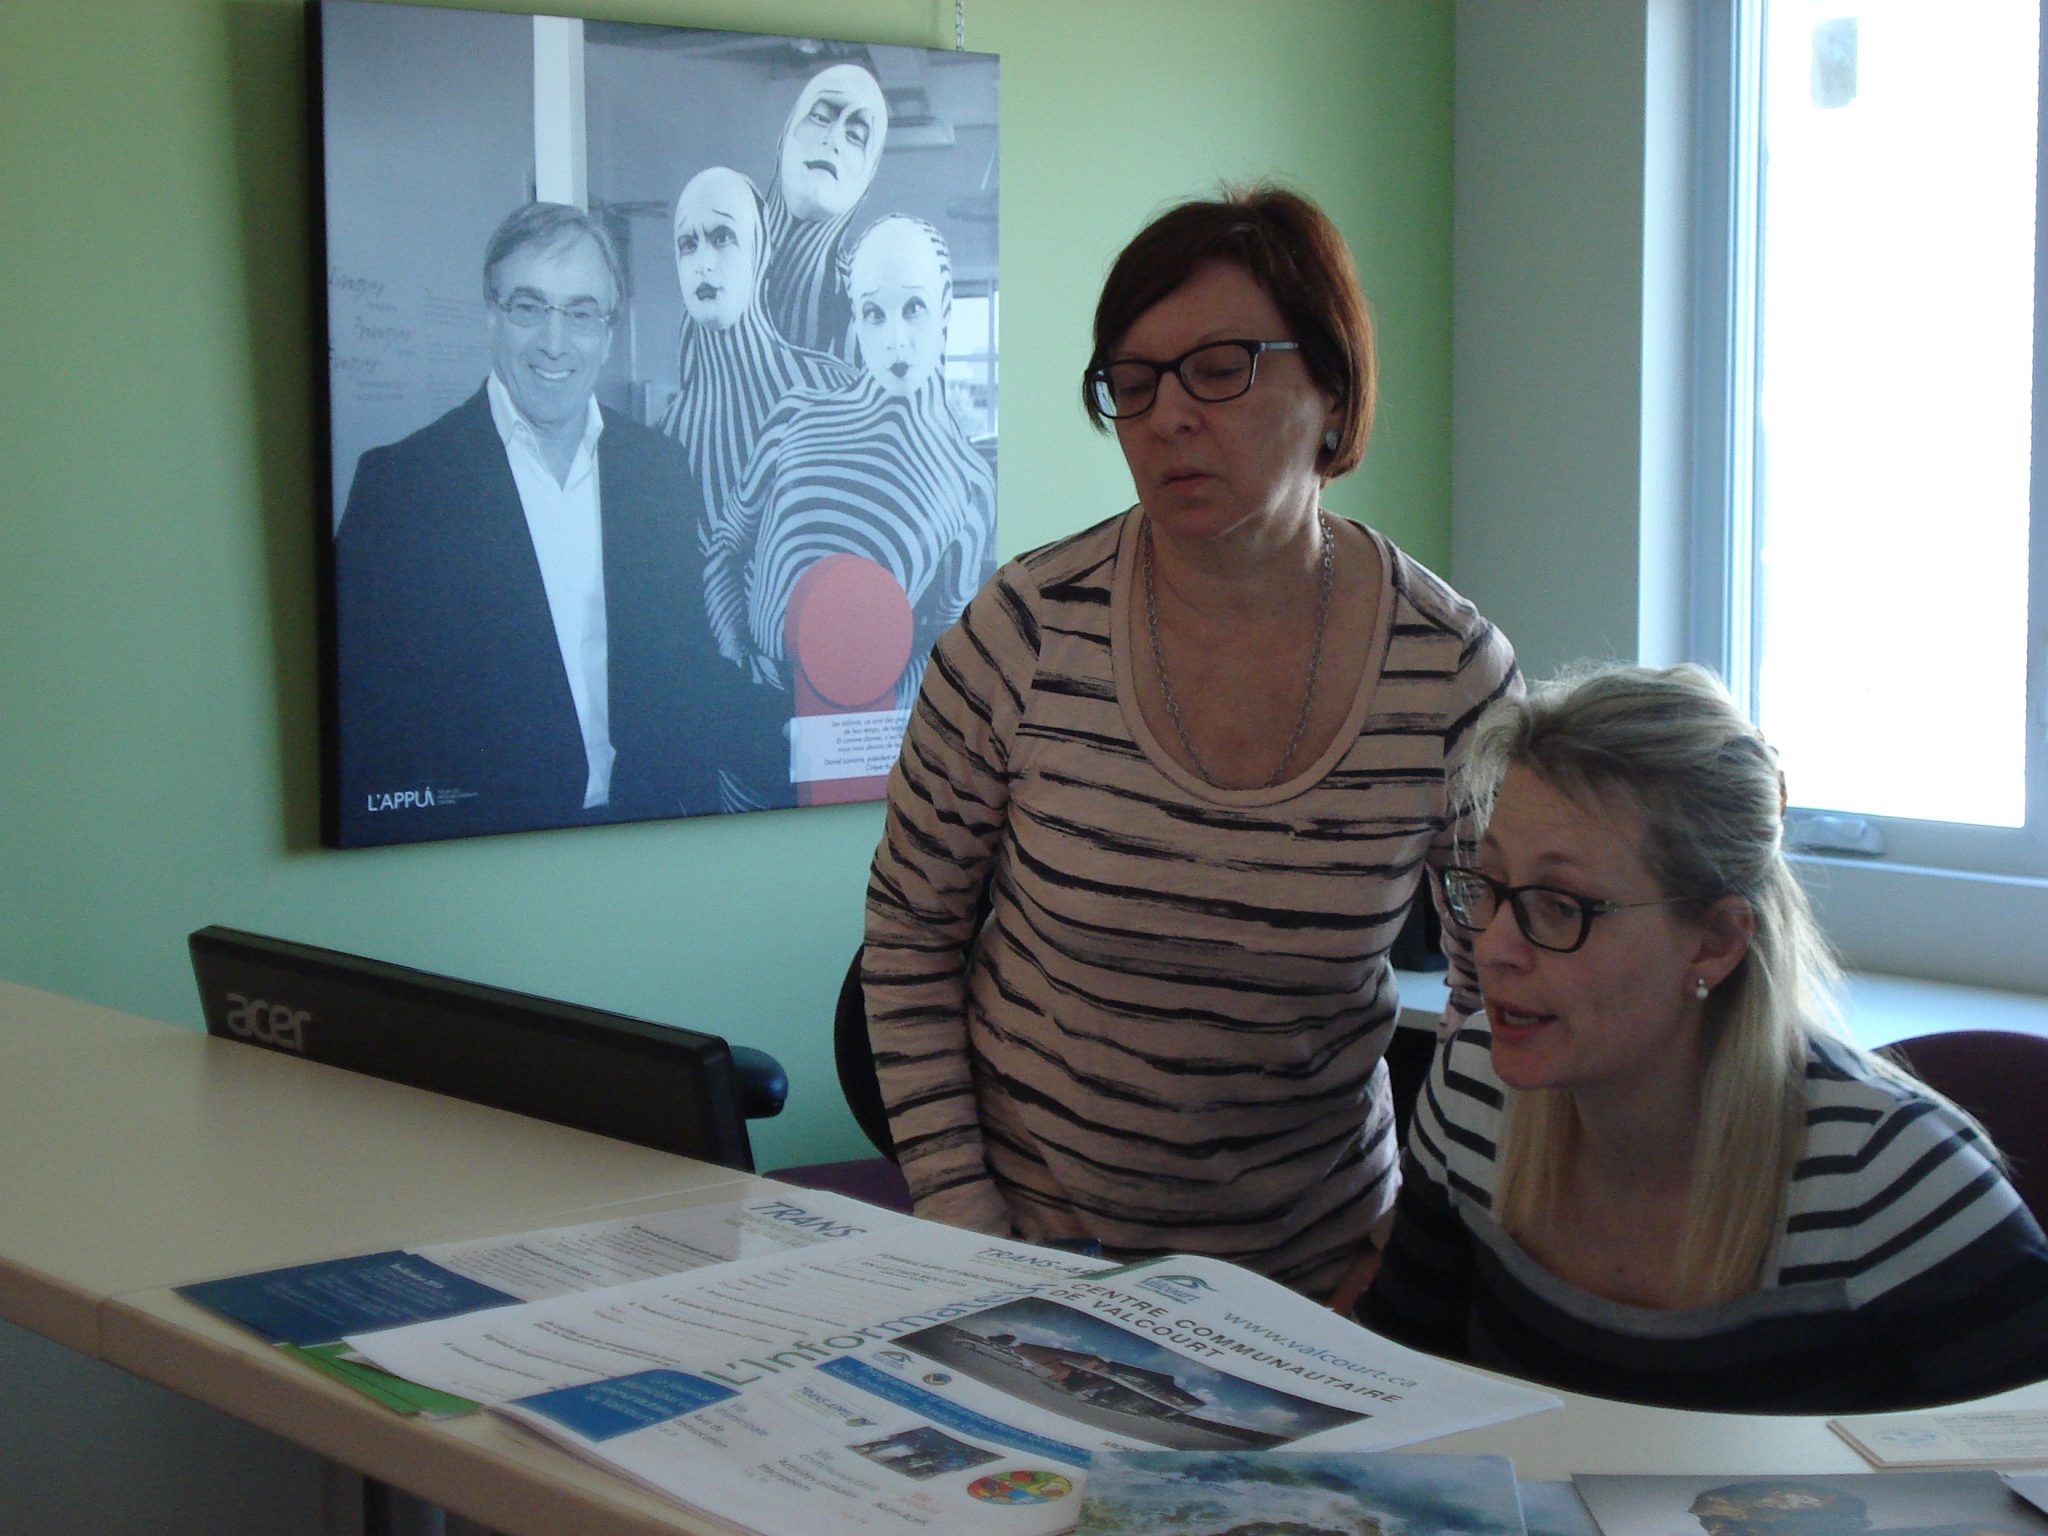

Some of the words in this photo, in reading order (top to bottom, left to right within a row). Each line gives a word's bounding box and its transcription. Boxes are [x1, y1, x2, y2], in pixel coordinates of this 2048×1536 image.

[226, 993, 311, 1051] acer
[749, 1202, 867, 1237] TRANS
[1049, 1290, 1087, 1302] DE
[1093, 1301, 1225, 1358] VALCOURT
[1071, 1284, 1169, 1318] CENTRE
[1175, 1319, 1404, 1404] COMMUNAUTAIRE
[1223, 1312, 1418, 1388] www.valcourt.ca
